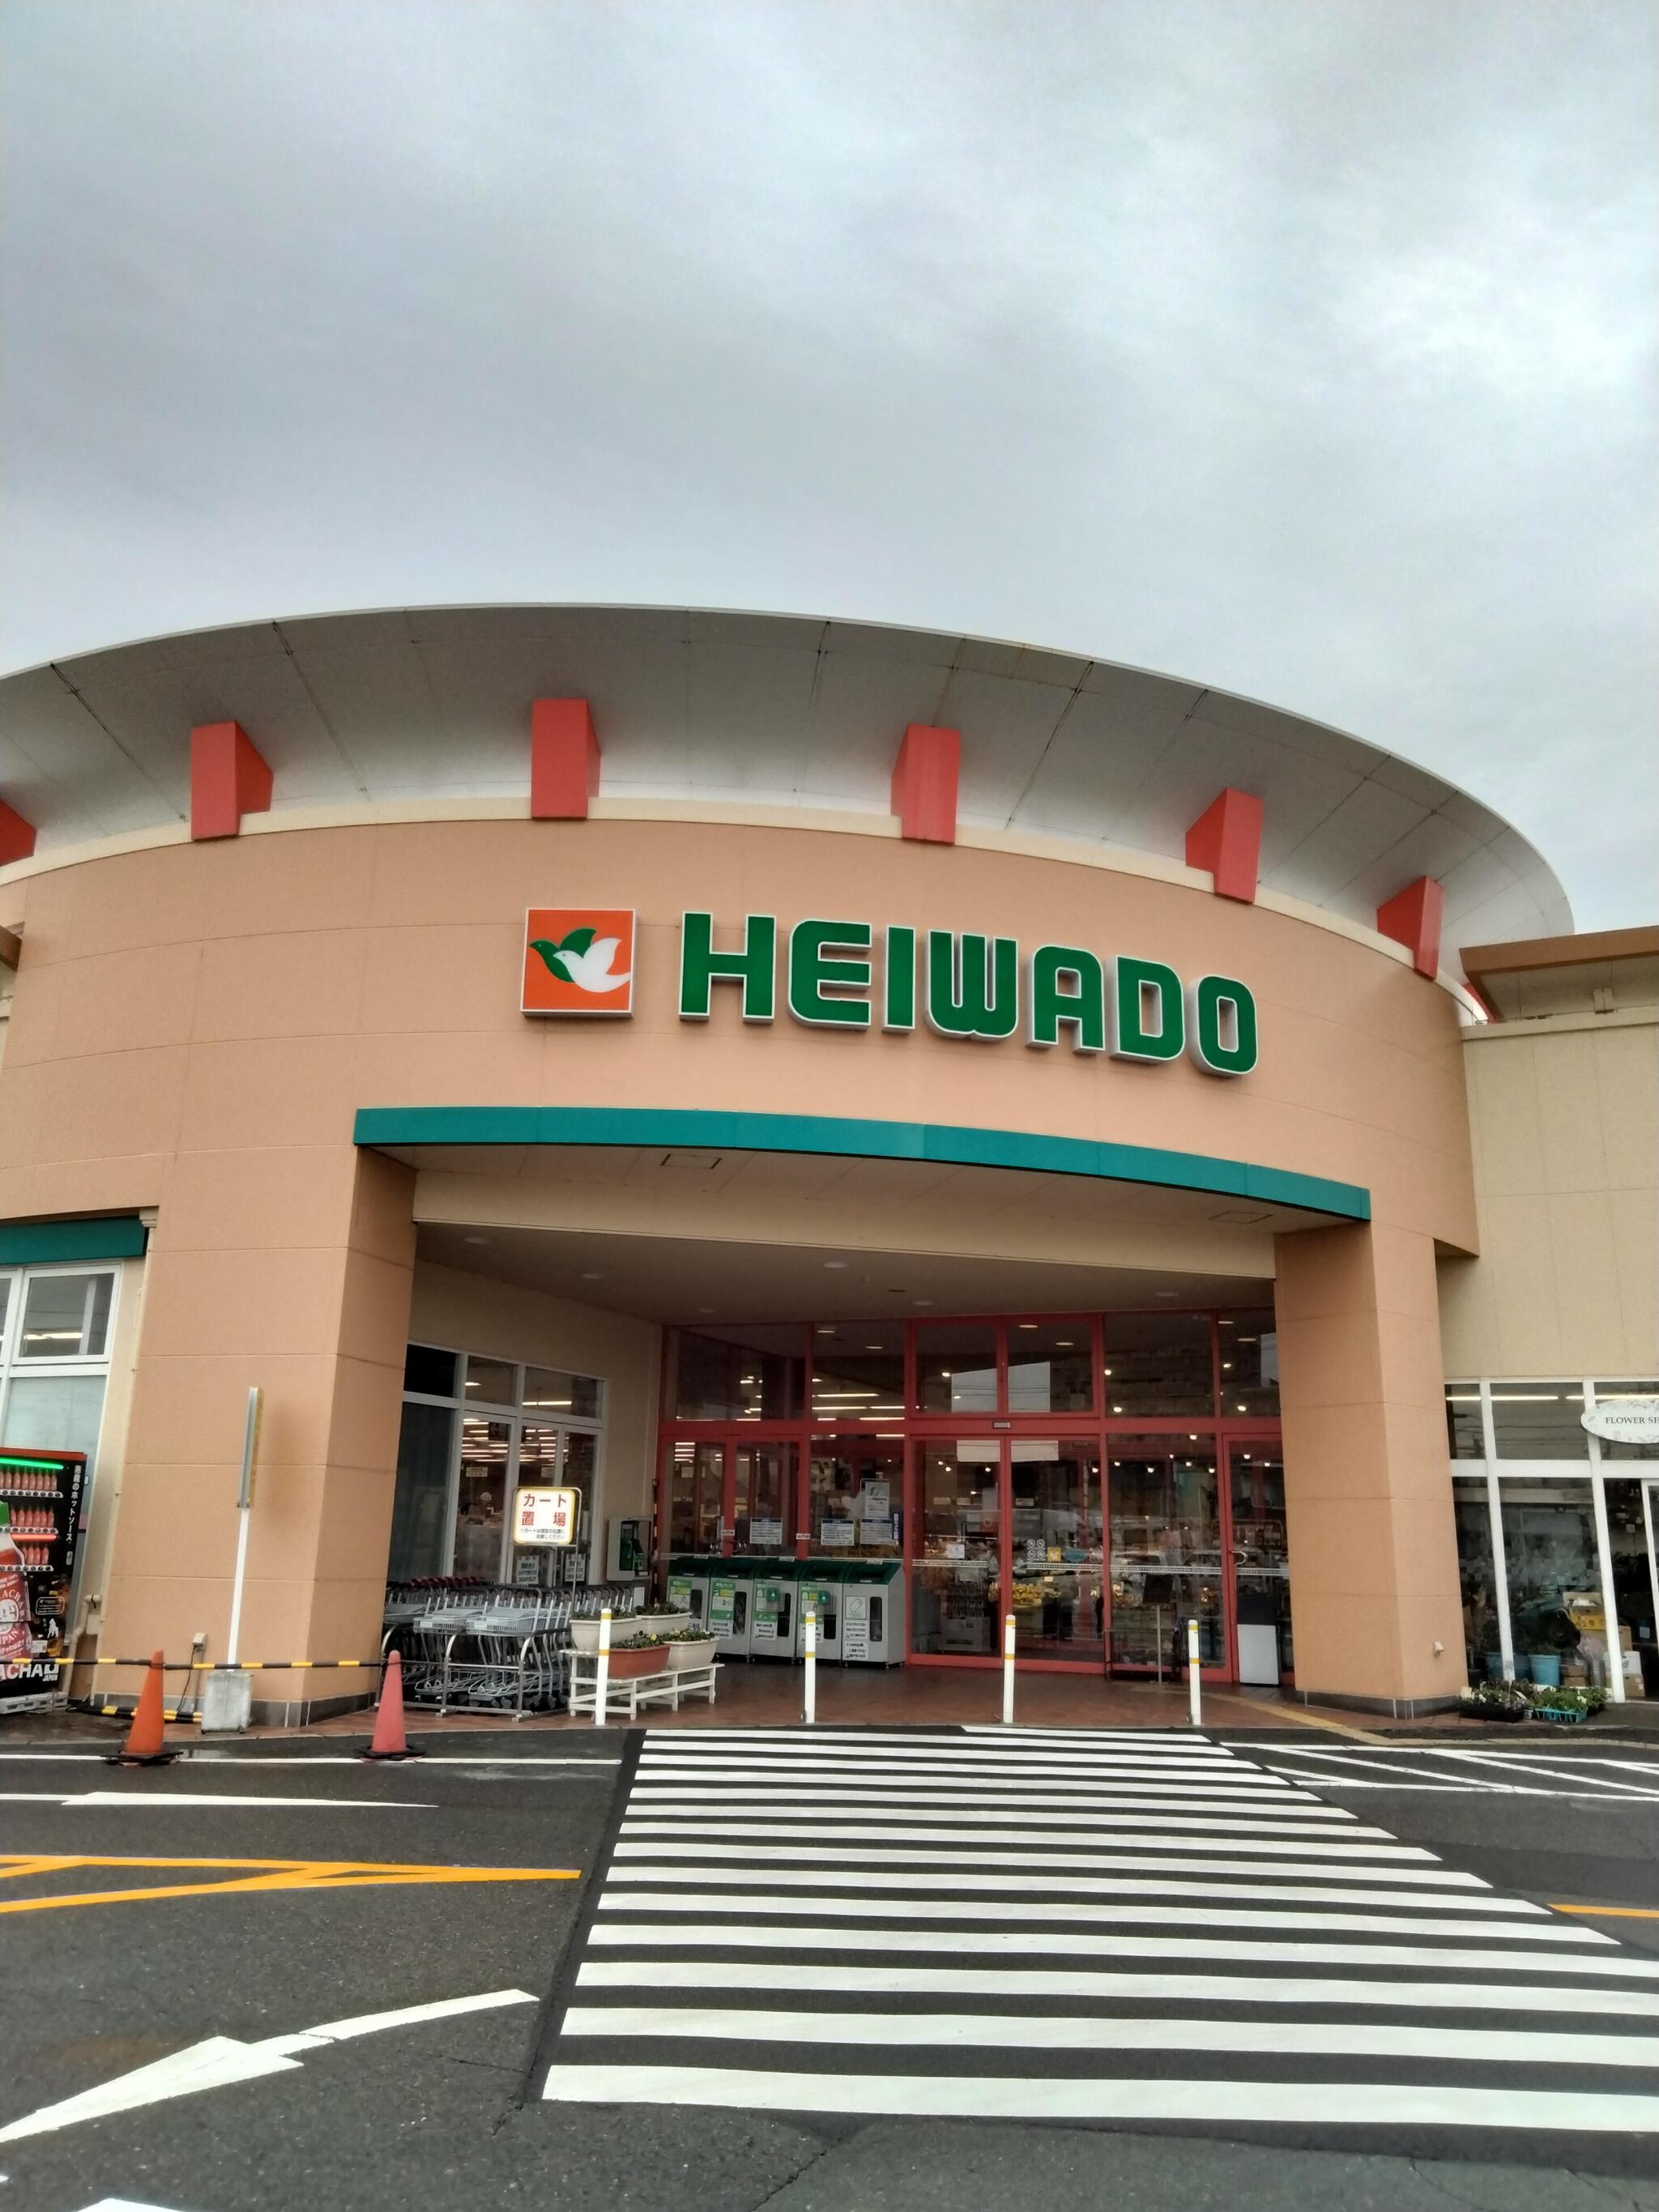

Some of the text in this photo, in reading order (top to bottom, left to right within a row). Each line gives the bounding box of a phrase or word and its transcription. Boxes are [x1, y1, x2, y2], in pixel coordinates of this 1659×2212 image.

[678, 910, 1259, 1077] HEIWADO
[1605, 1416, 1646, 1425] FLOWER
[523, 1493, 567, 1508] カート
[522, 1511, 566, 1527] 置場
